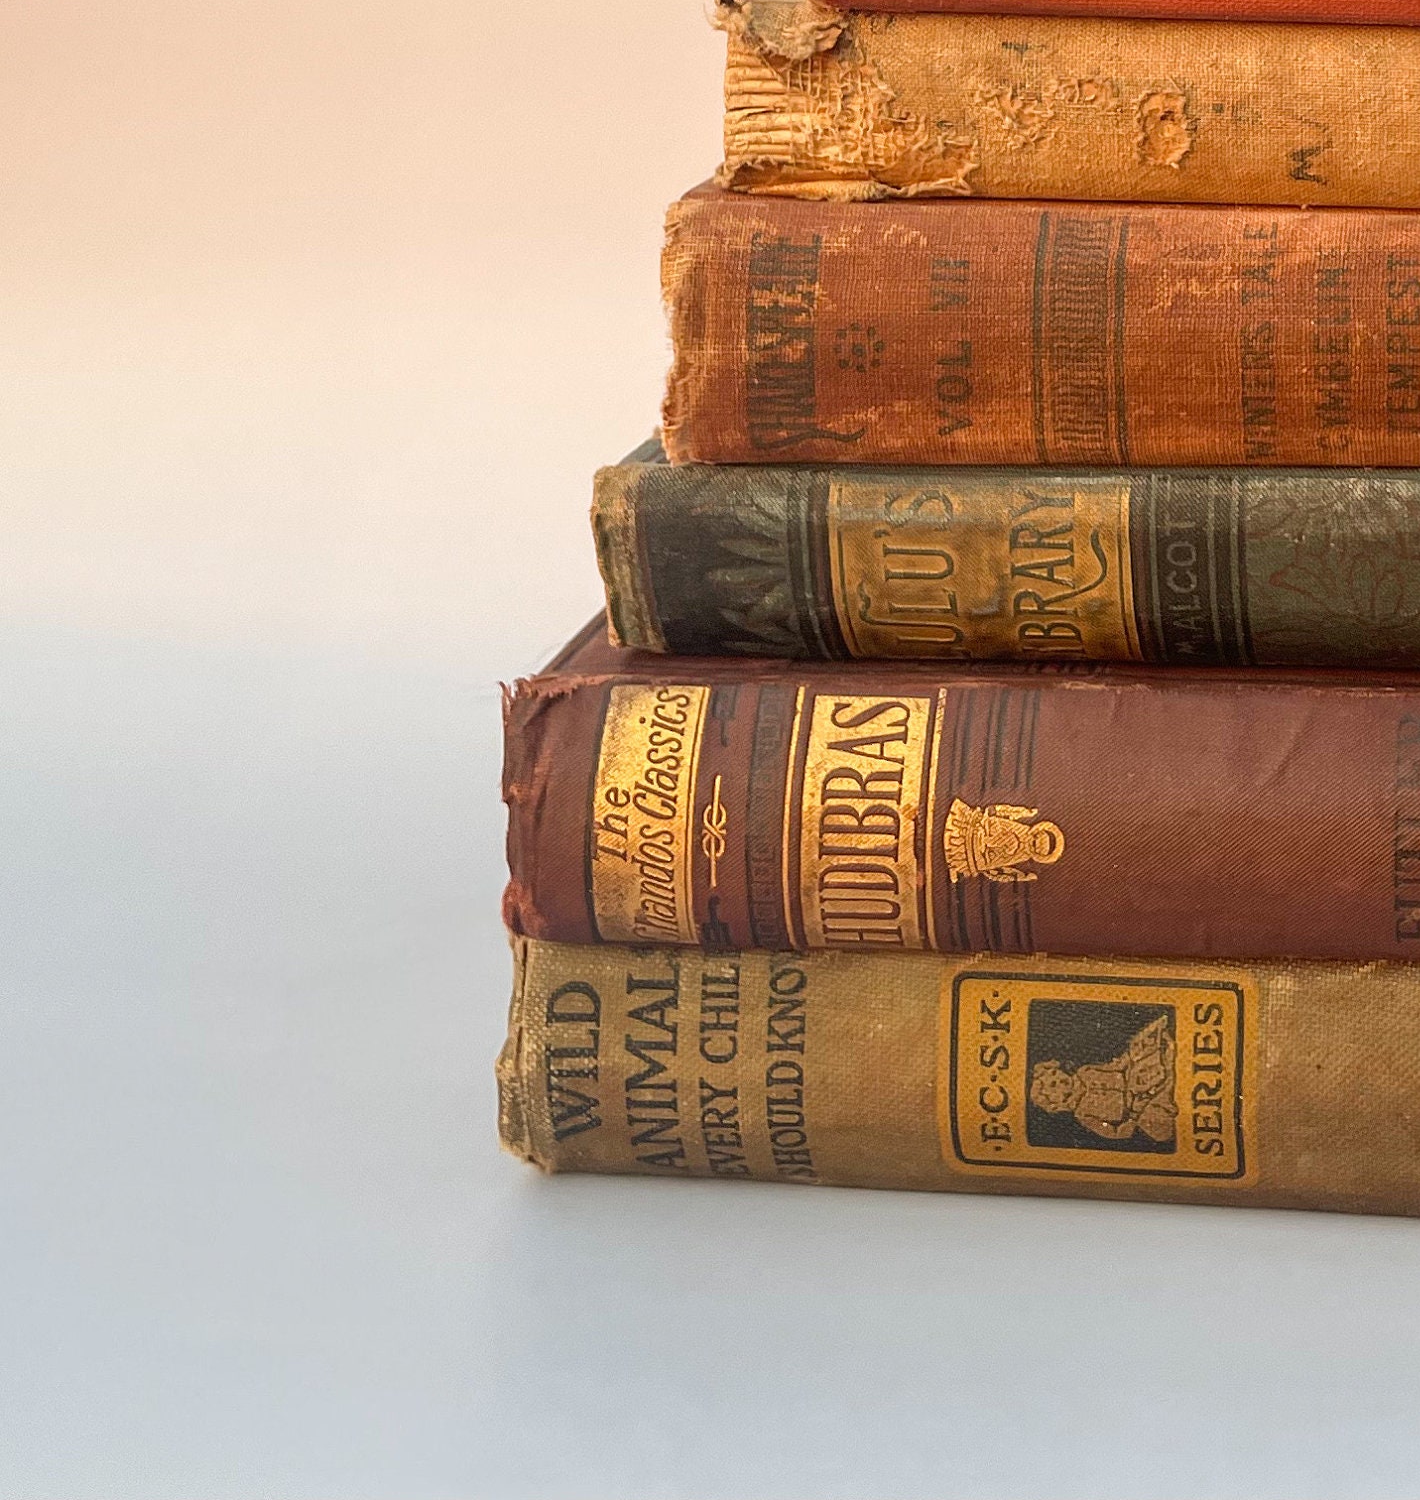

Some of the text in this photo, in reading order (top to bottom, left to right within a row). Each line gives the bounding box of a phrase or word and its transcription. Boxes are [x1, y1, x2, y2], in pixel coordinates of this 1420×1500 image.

[858, 489, 968, 652] ULU'S
[1006, 487, 1108, 658] IBRARY
[594, 785, 631, 862] The
[631, 688, 690, 940] Chandos Classics
[818, 701, 911, 944] HUDIBRAS
[545, 979, 602, 1143] WILD
[625, 948, 690, 1169] ANIMAL
[700, 950, 742, 1064] CHIL
[1192, 1002, 1225, 1157] SERIES
